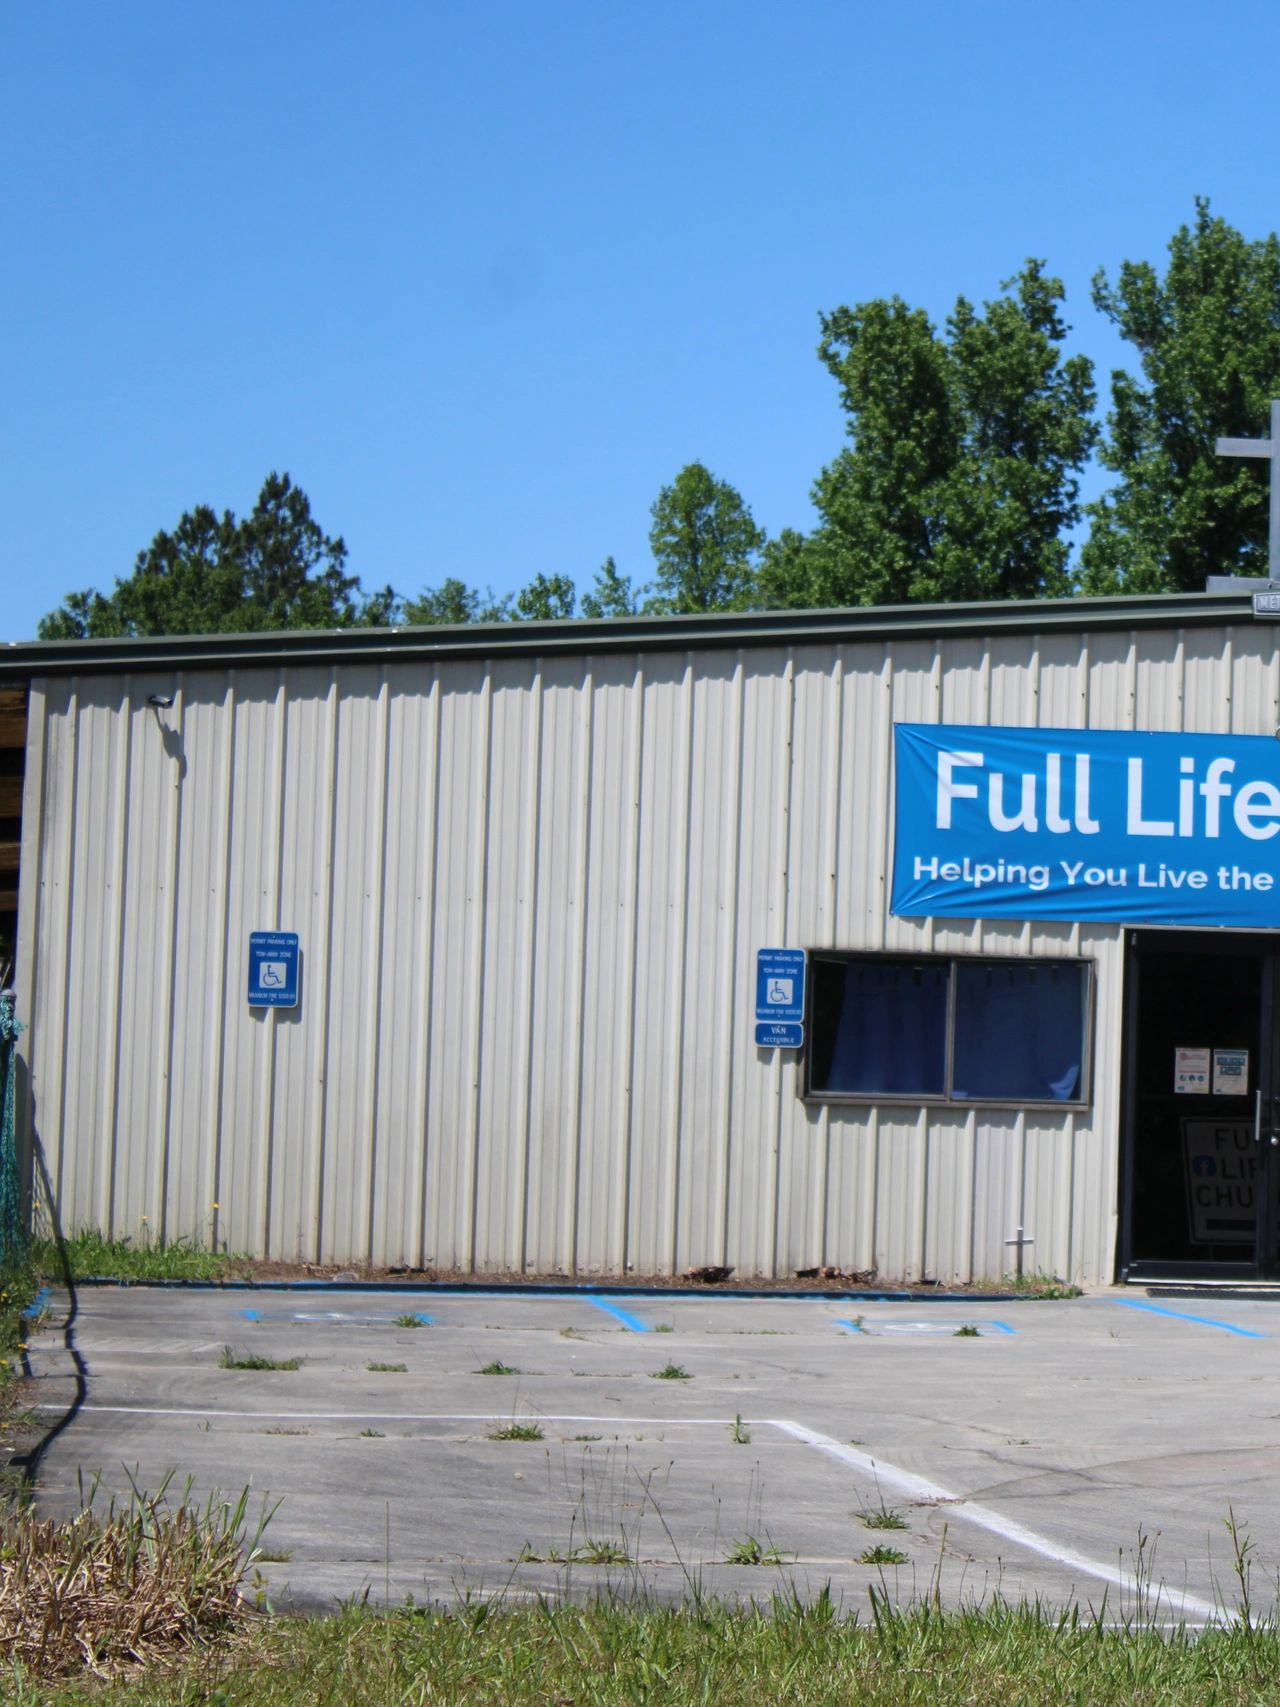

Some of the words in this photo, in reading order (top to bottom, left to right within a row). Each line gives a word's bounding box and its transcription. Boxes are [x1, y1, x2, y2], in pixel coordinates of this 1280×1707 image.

[937, 752, 1099, 834] Full
[914, 857, 1049, 890] Helping
[1061, 862, 1126, 885] You
[1139, 864, 1207, 888] Live
[1218, 867, 1273, 890] the
[771, 1027, 786, 1035] VAN
